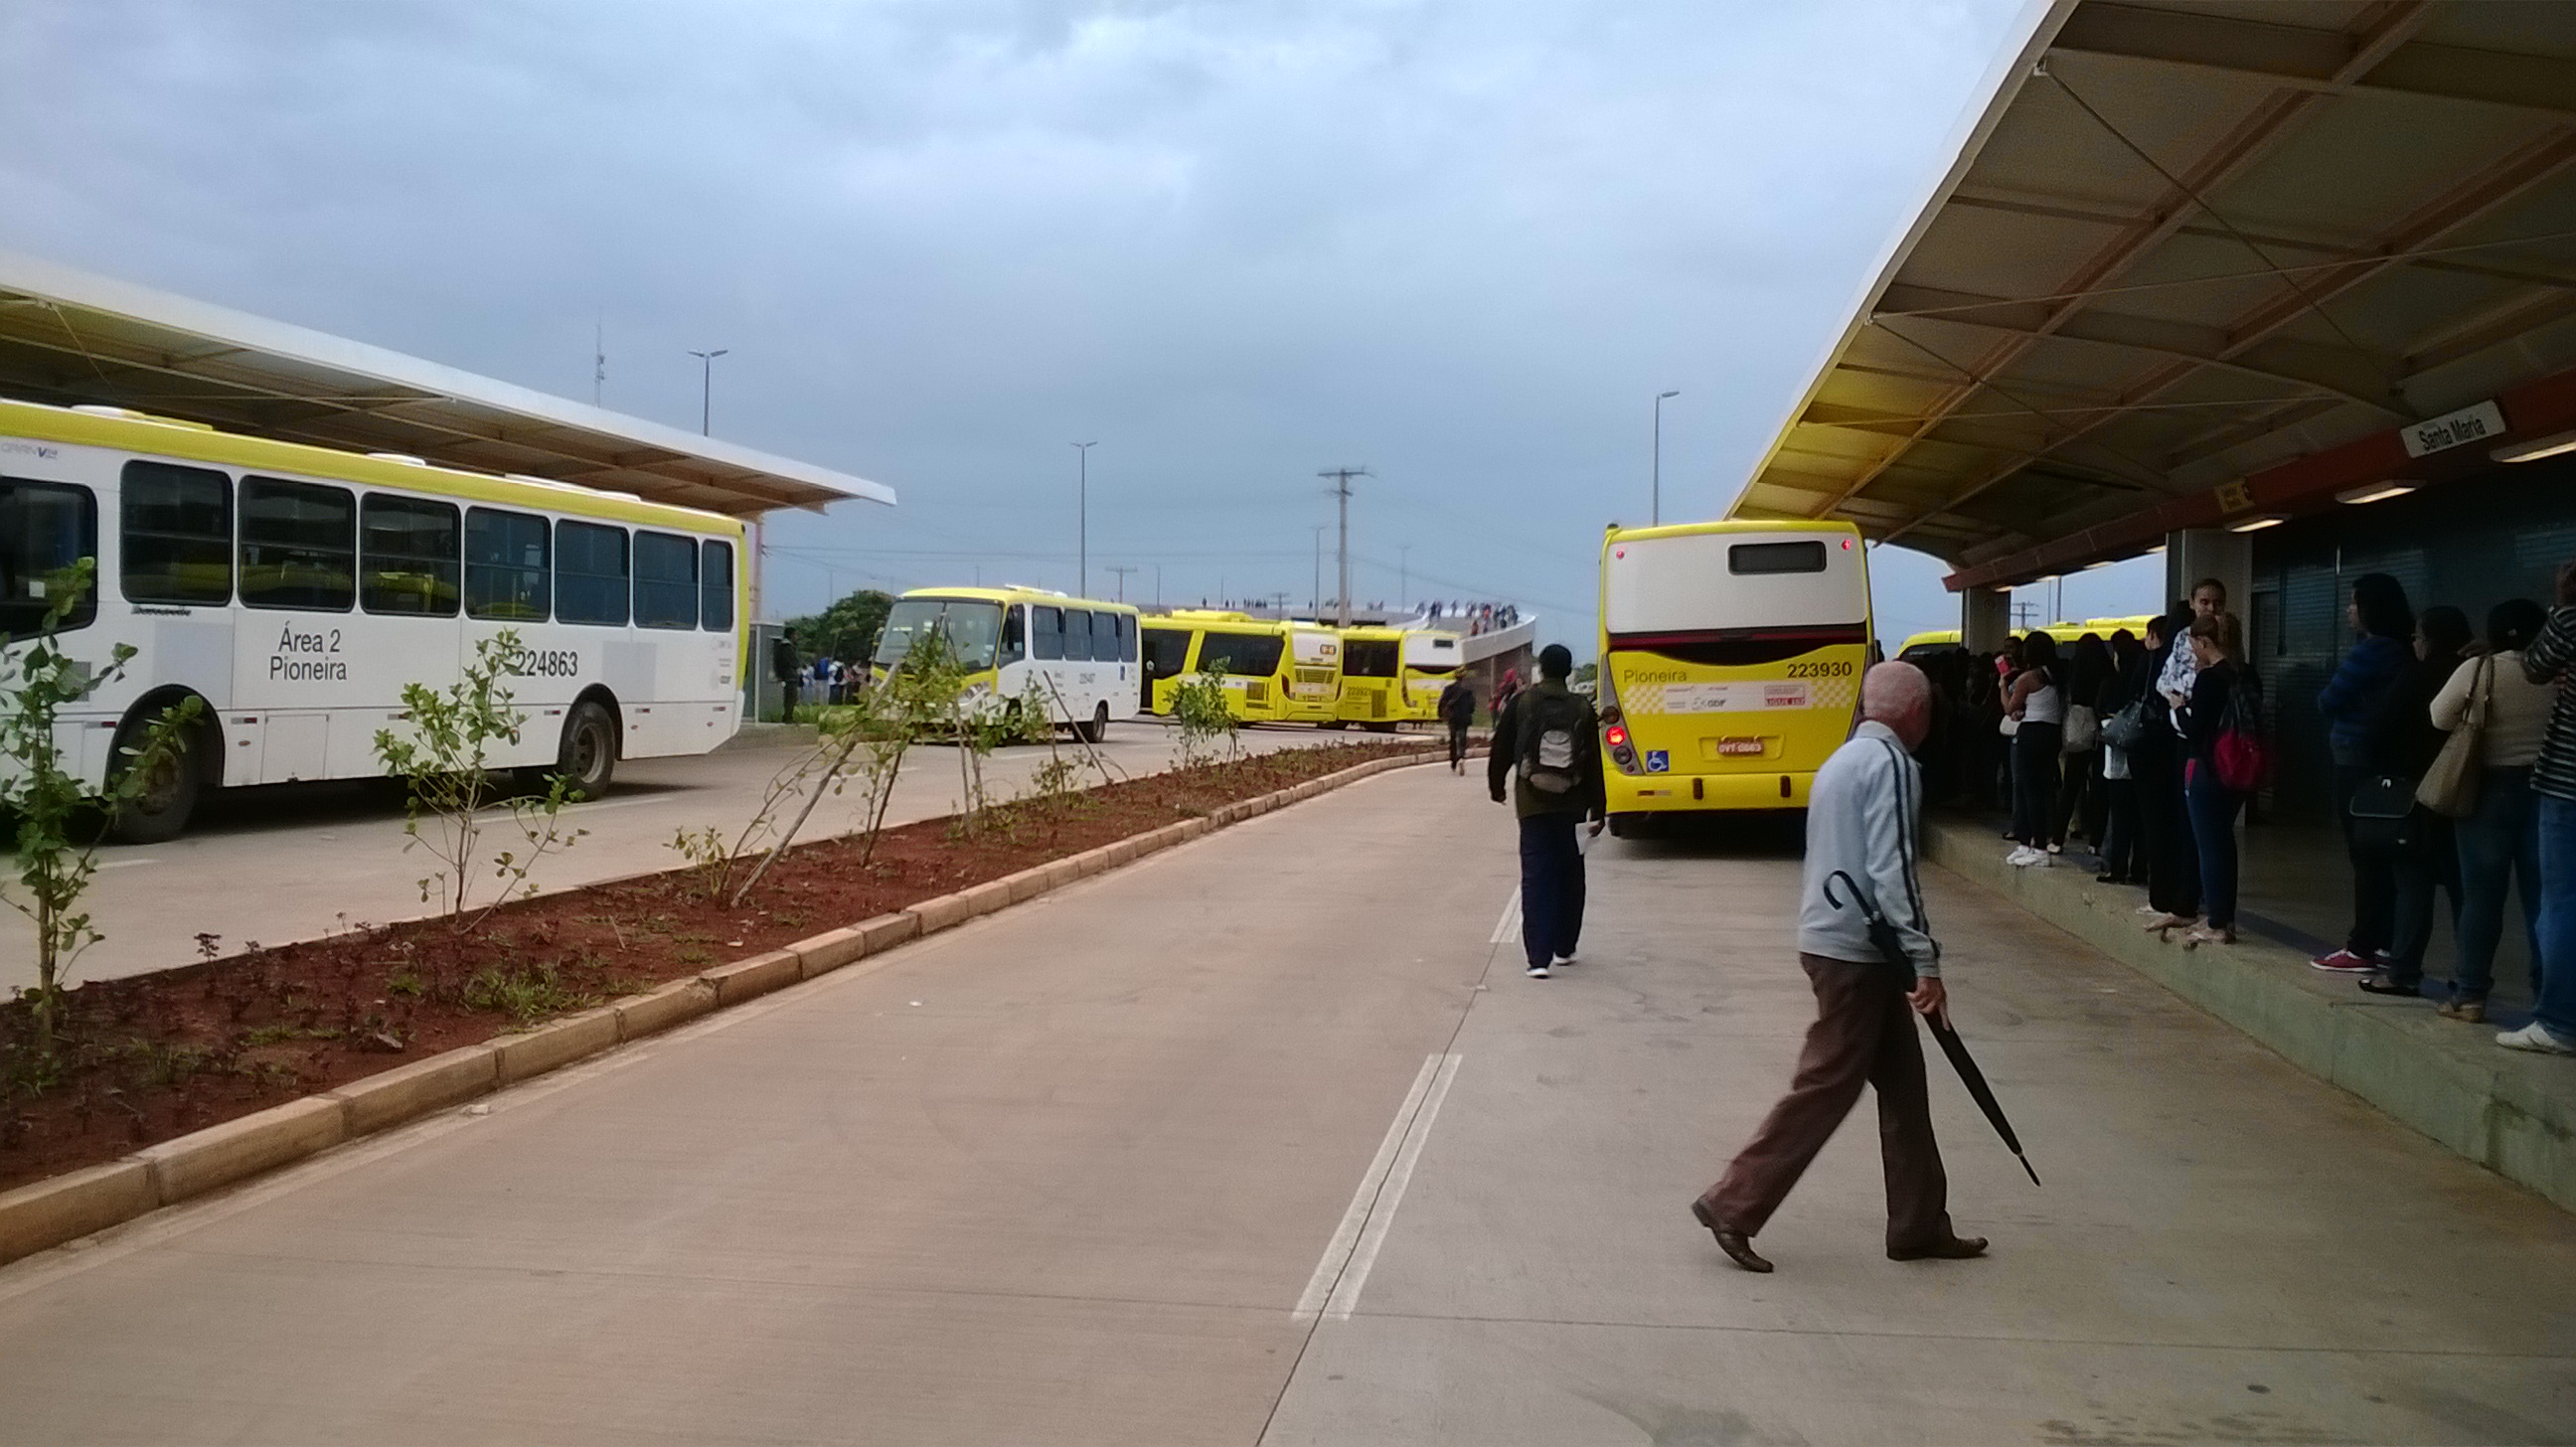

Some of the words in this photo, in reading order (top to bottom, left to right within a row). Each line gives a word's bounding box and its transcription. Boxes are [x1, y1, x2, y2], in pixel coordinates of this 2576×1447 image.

[2418, 425, 2454, 451] Santa
[2450, 414, 2487, 442] Maria
[278, 619, 324, 653] Área
[329, 628, 341, 653] 2
[269, 655, 347, 681] Pioneira
[513, 649, 578, 677] 224863
[1623, 668, 1688, 684] Pioneira
[1787, 661, 1852, 679] 223930
